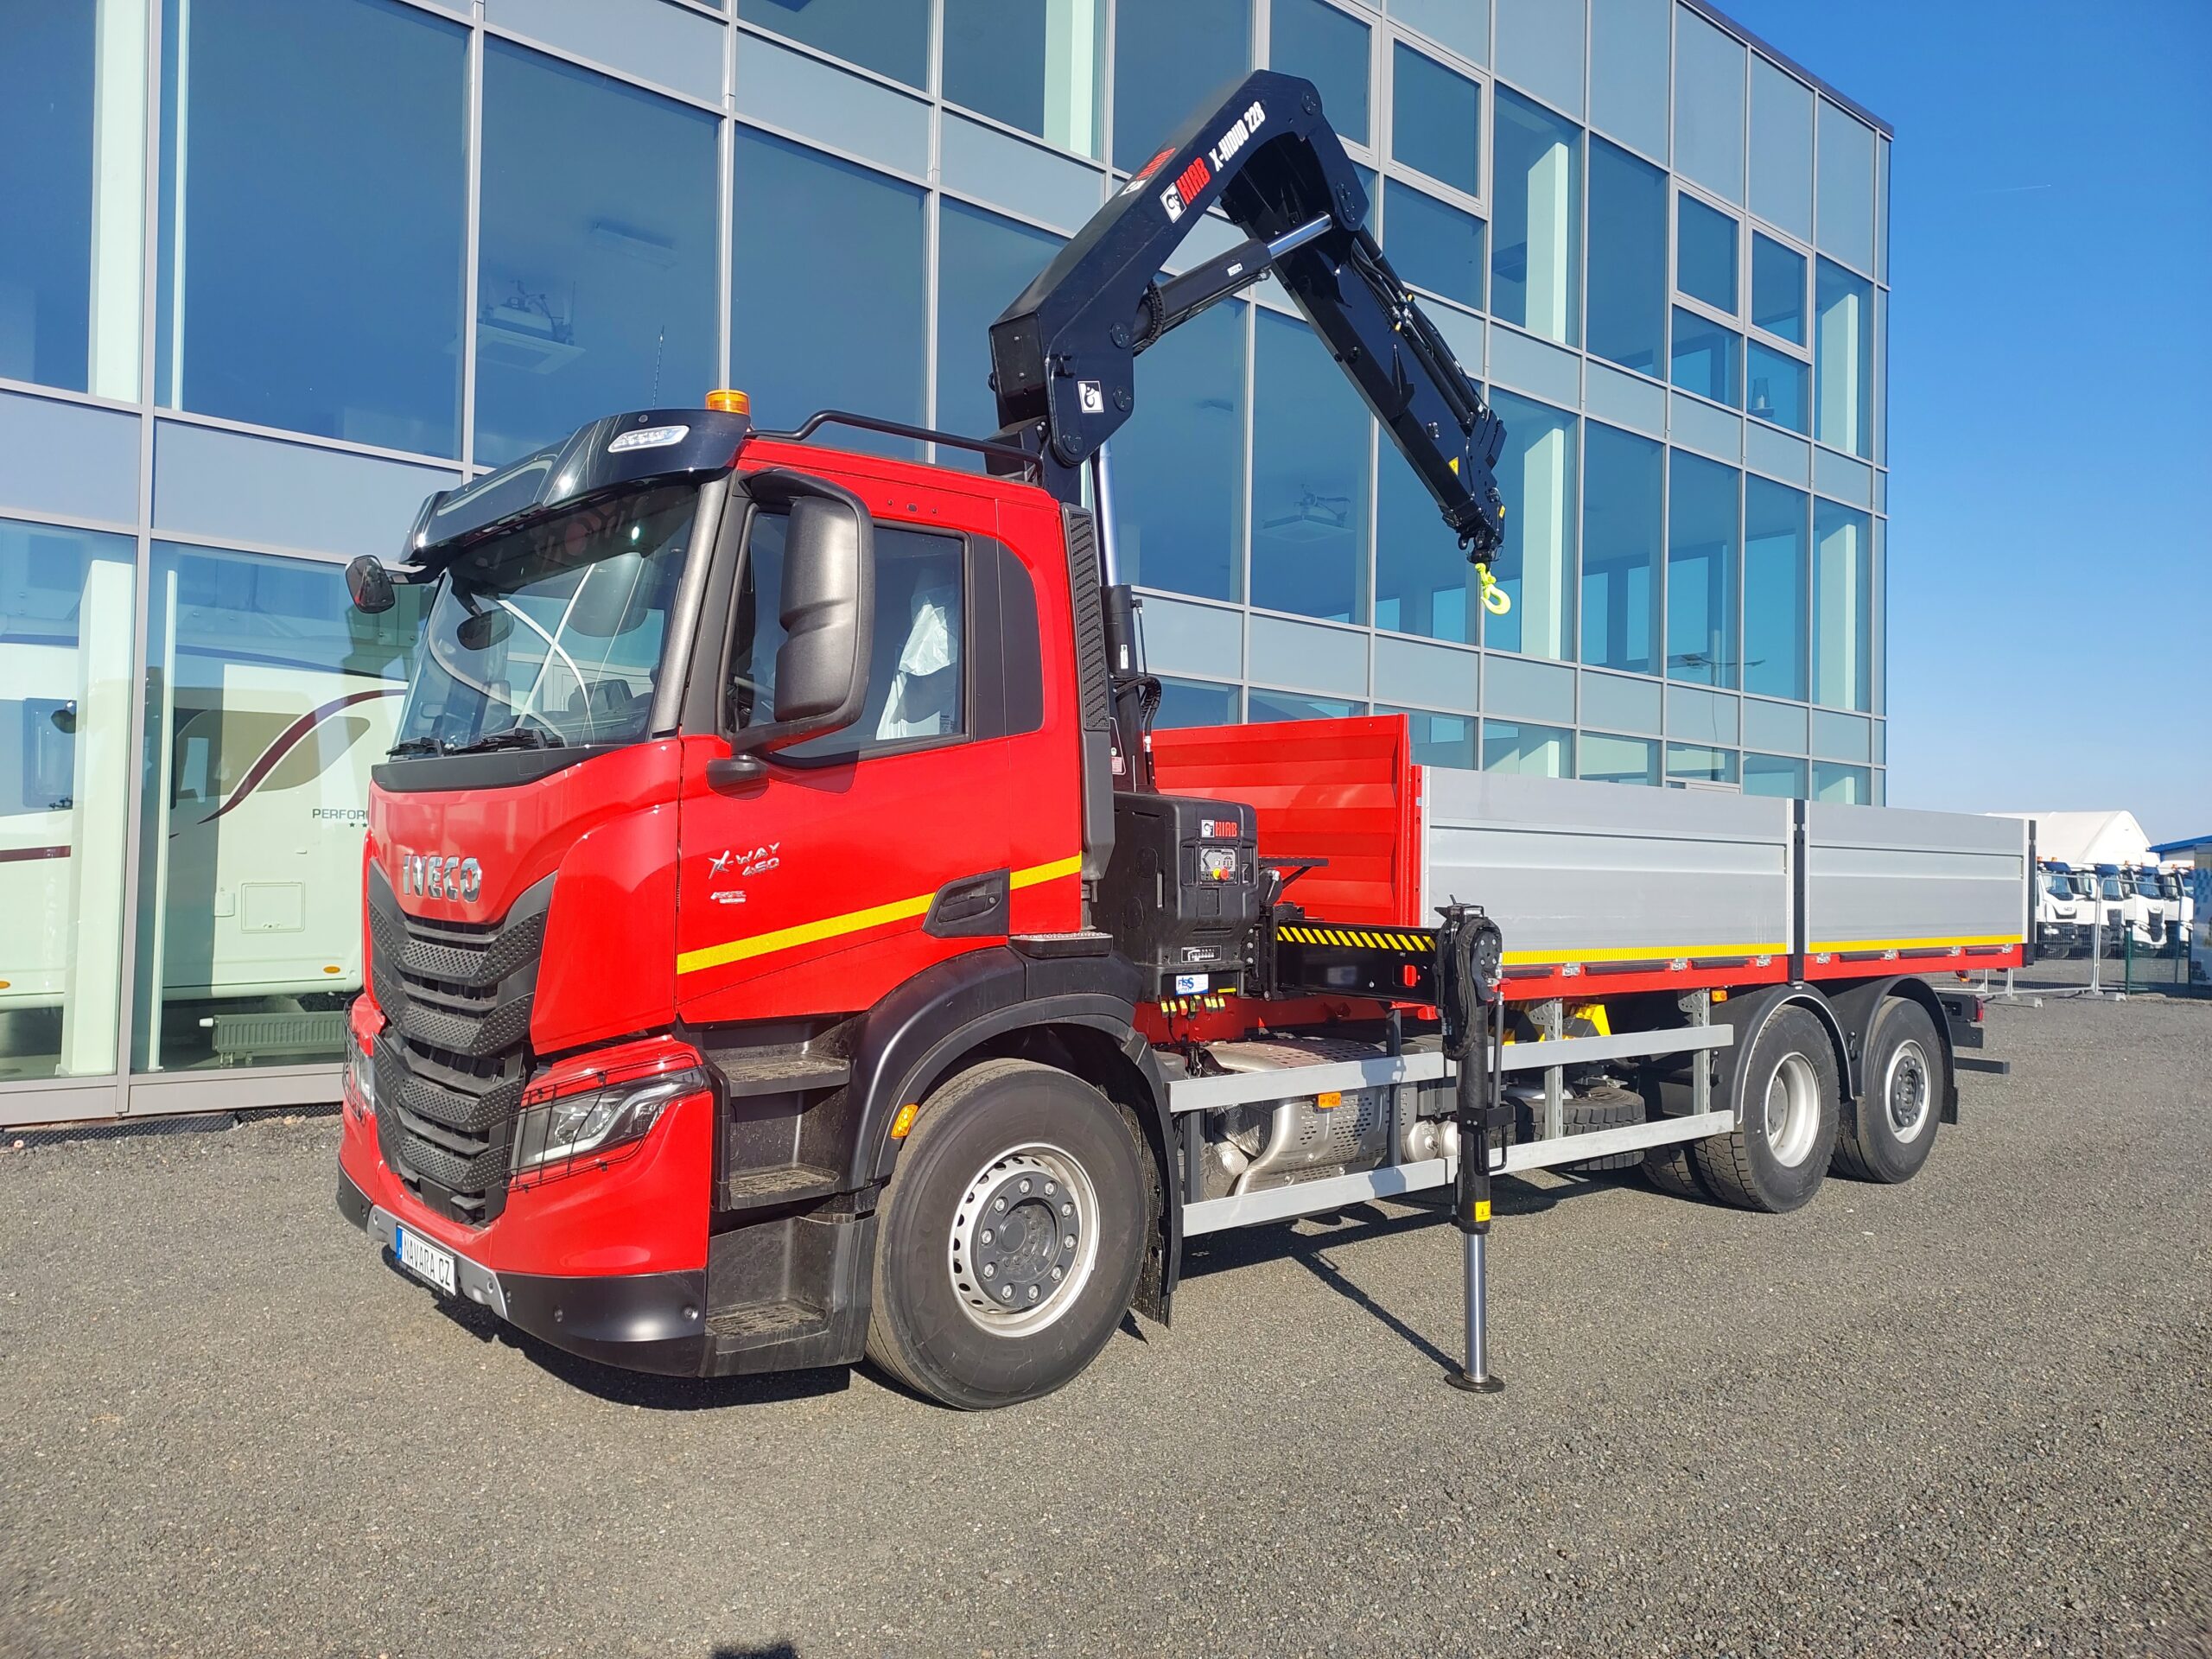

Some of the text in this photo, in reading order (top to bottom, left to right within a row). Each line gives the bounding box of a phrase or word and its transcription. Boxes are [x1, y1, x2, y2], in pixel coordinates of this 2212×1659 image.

[1176, 101, 1266, 206] HIAB X-HIDUO 228
[1215, 822, 1237, 837] HIAB
[403, 855, 482, 903] IVECO
[709, 842, 780, 880] X-WAY
[404, 1235, 435, 1280] NAVARA
[438, 1257, 450, 1287] CZ
